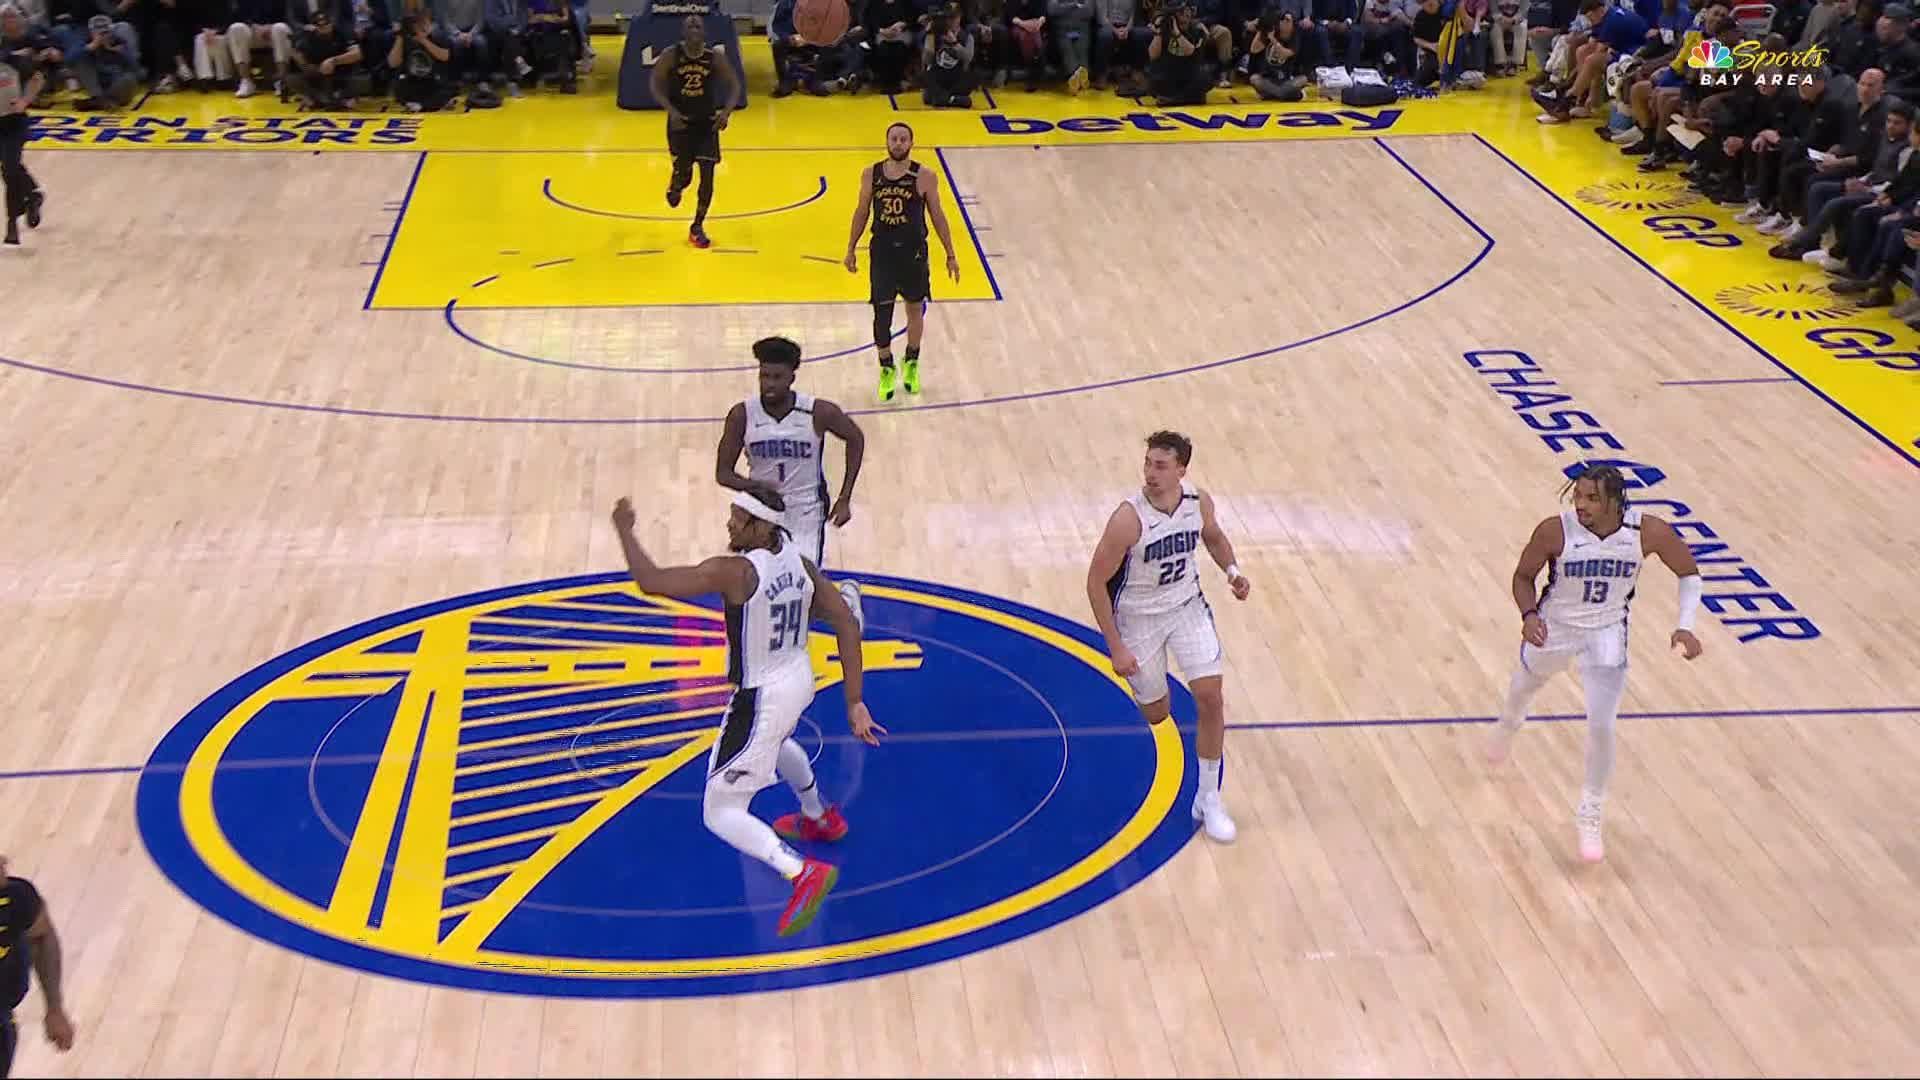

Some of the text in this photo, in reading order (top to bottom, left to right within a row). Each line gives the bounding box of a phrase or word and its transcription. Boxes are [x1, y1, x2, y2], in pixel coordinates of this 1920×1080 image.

[684, 74, 702, 89] 23
[28, 116, 425, 129] DEN STATE
[980, 109, 1403, 136] betway
[27, 128, 416, 143] RRIORS
[875, 186, 913, 199] GOLDEN
[881, 197, 903, 215] 30
[1463, 350, 1625, 453] CHASE
[750, 439, 811, 459] MAGIC
[776, 462, 785, 482] 1
[1143, 530, 1199, 563] MAGIC
[1159, 558, 1186, 586] 22
[1564, 559, 1637, 578] MAGIC
[1583, 580, 1609, 604] 13
[769, 599, 802, 652] 34
